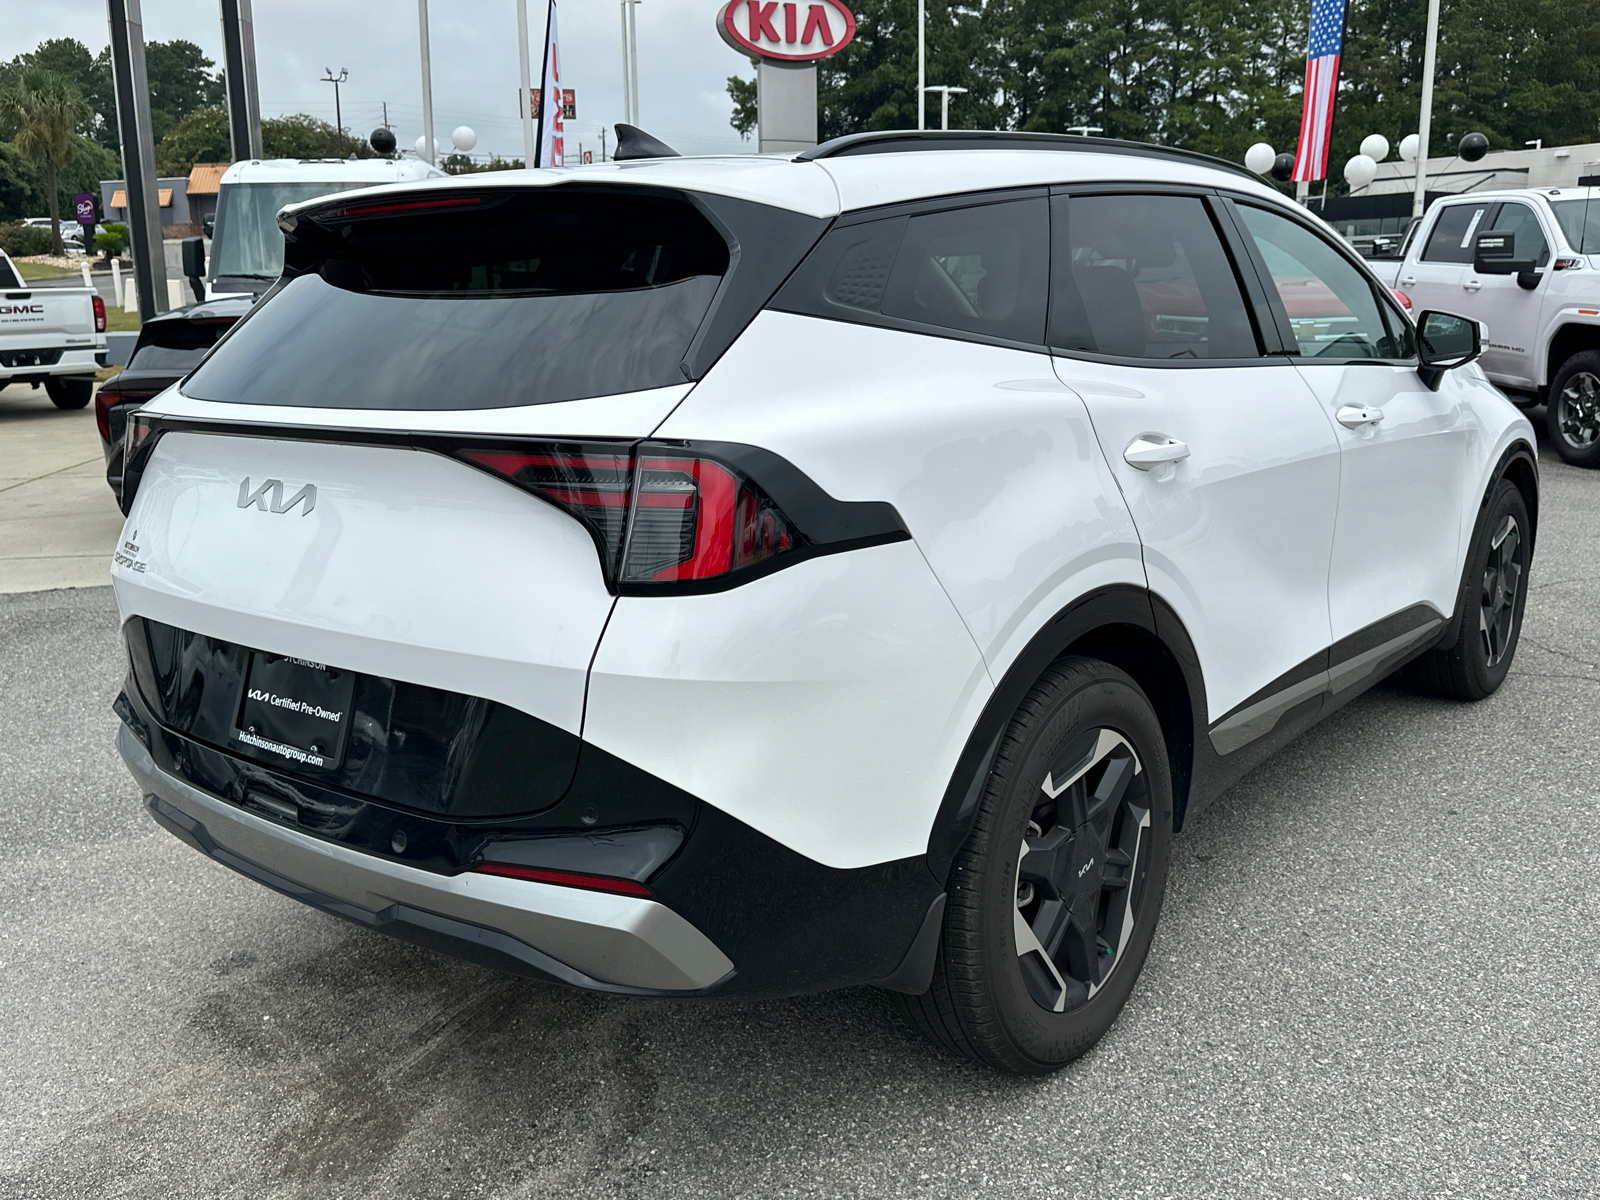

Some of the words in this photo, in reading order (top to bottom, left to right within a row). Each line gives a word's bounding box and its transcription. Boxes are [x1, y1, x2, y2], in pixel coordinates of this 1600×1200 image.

[746, 0, 834, 45] KIA
[0, 305, 44, 314] GMC
[284, 656, 326, 671] TCHINSON
[270, 694, 301, 712] Certified
[301, 702, 341, 723] Pre-Owned
[238, 730, 323, 767] Hutchinsonautogroup.com
